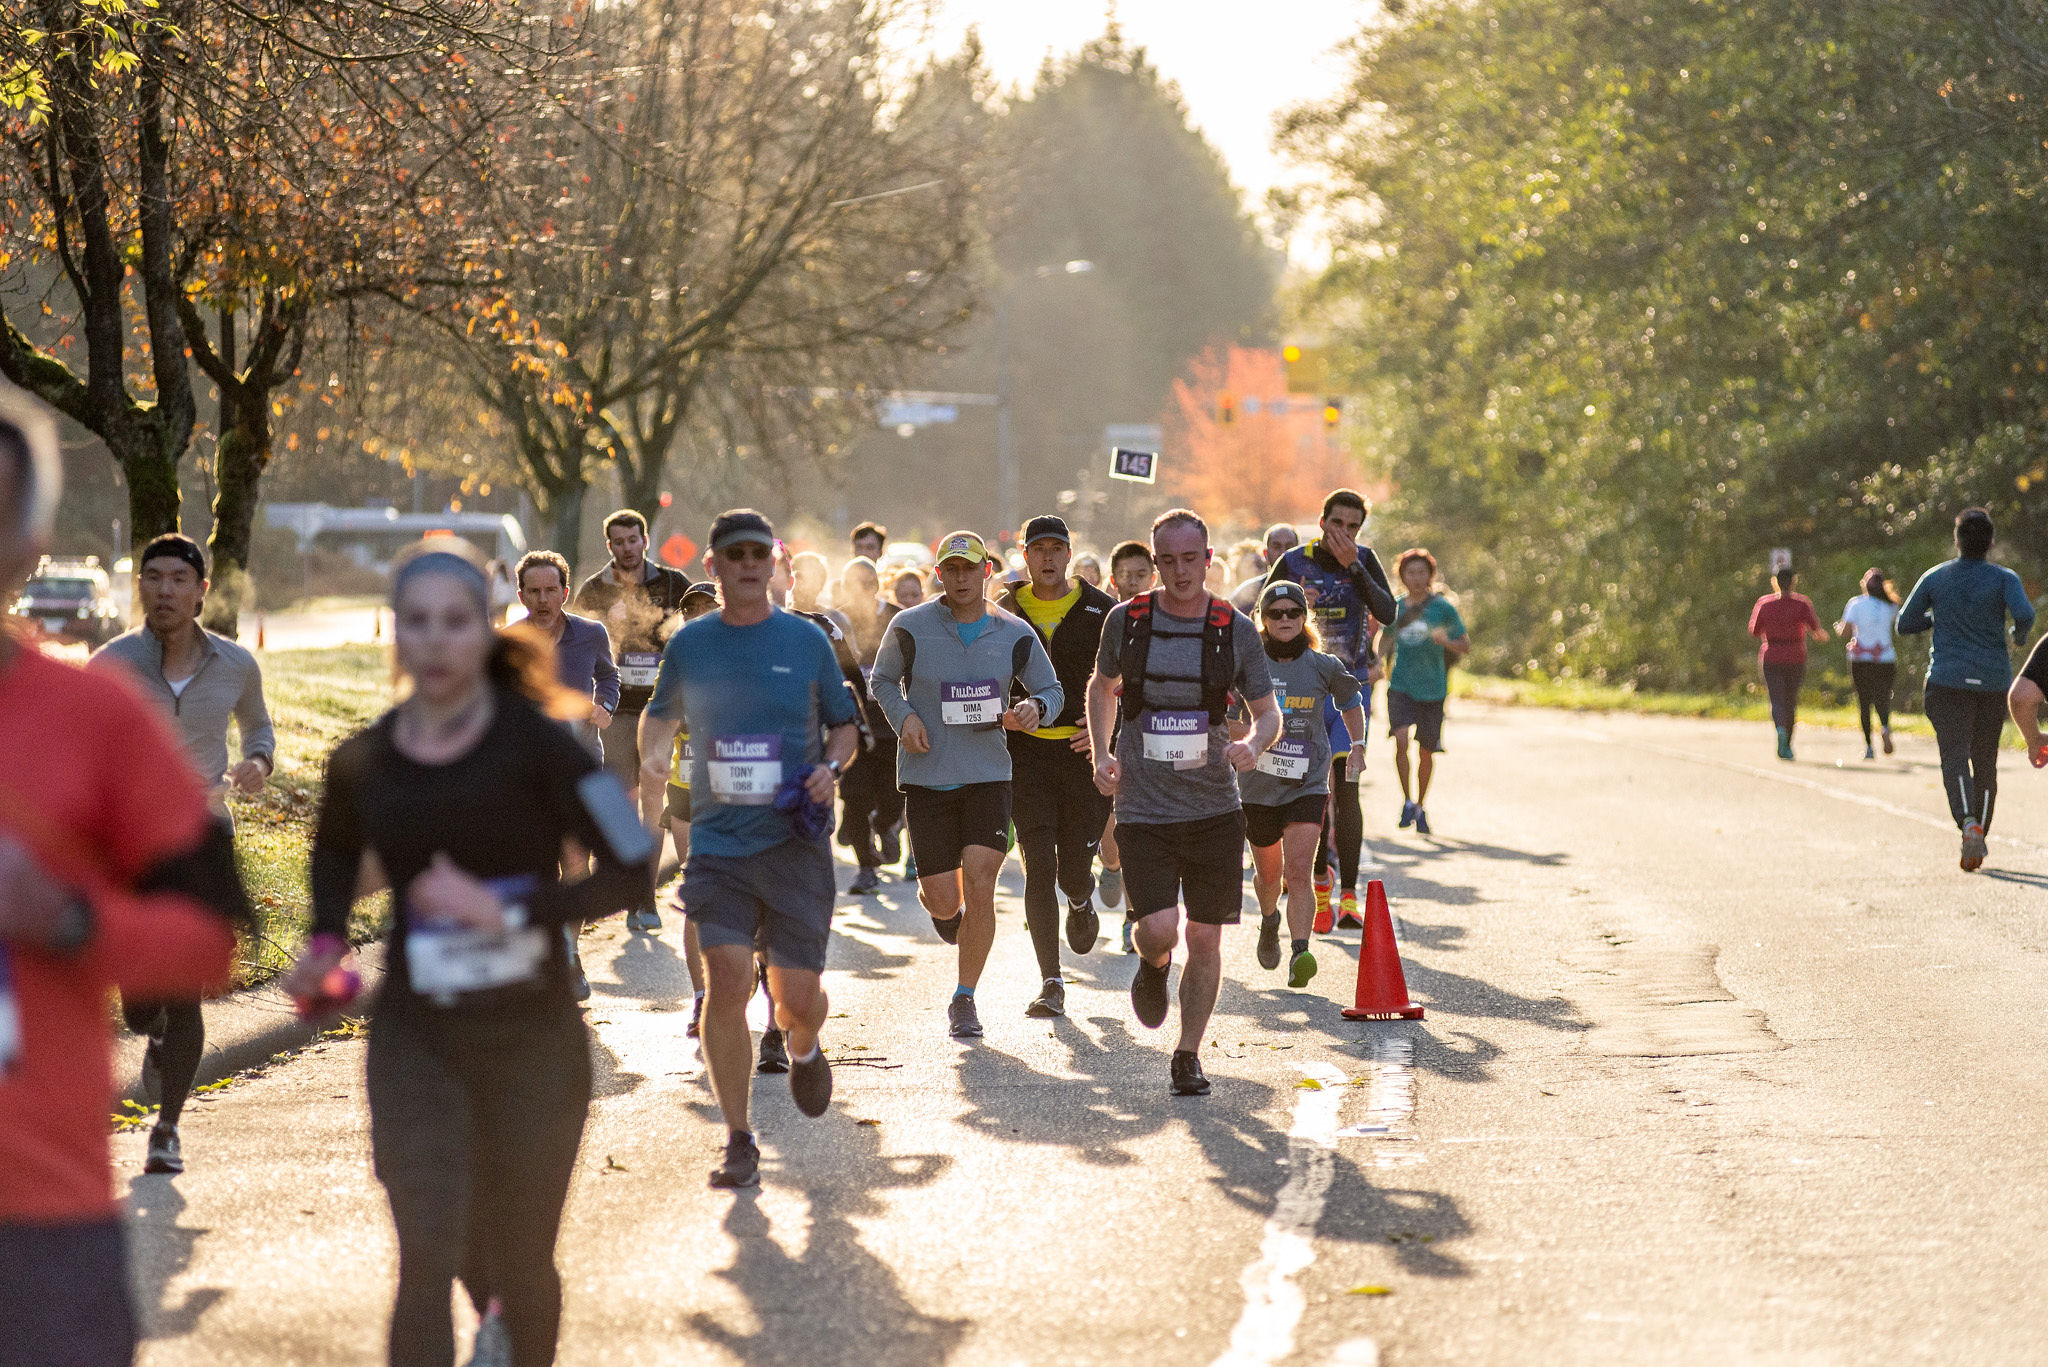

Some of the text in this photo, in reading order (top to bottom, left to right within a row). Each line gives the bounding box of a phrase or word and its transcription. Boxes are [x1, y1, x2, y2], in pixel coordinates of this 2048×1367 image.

[1120, 453, 1150, 475] 145
[963, 703, 982, 713] DIMA
[966, 714, 982, 723] 1253
[1165, 750, 1184, 760] 1540
[1272, 756, 1295, 768] DENISE
[729, 766, 754, 778] TONY
[1276, 767, 1288, 776] 925
[732, 781, 753, 792] 1068
